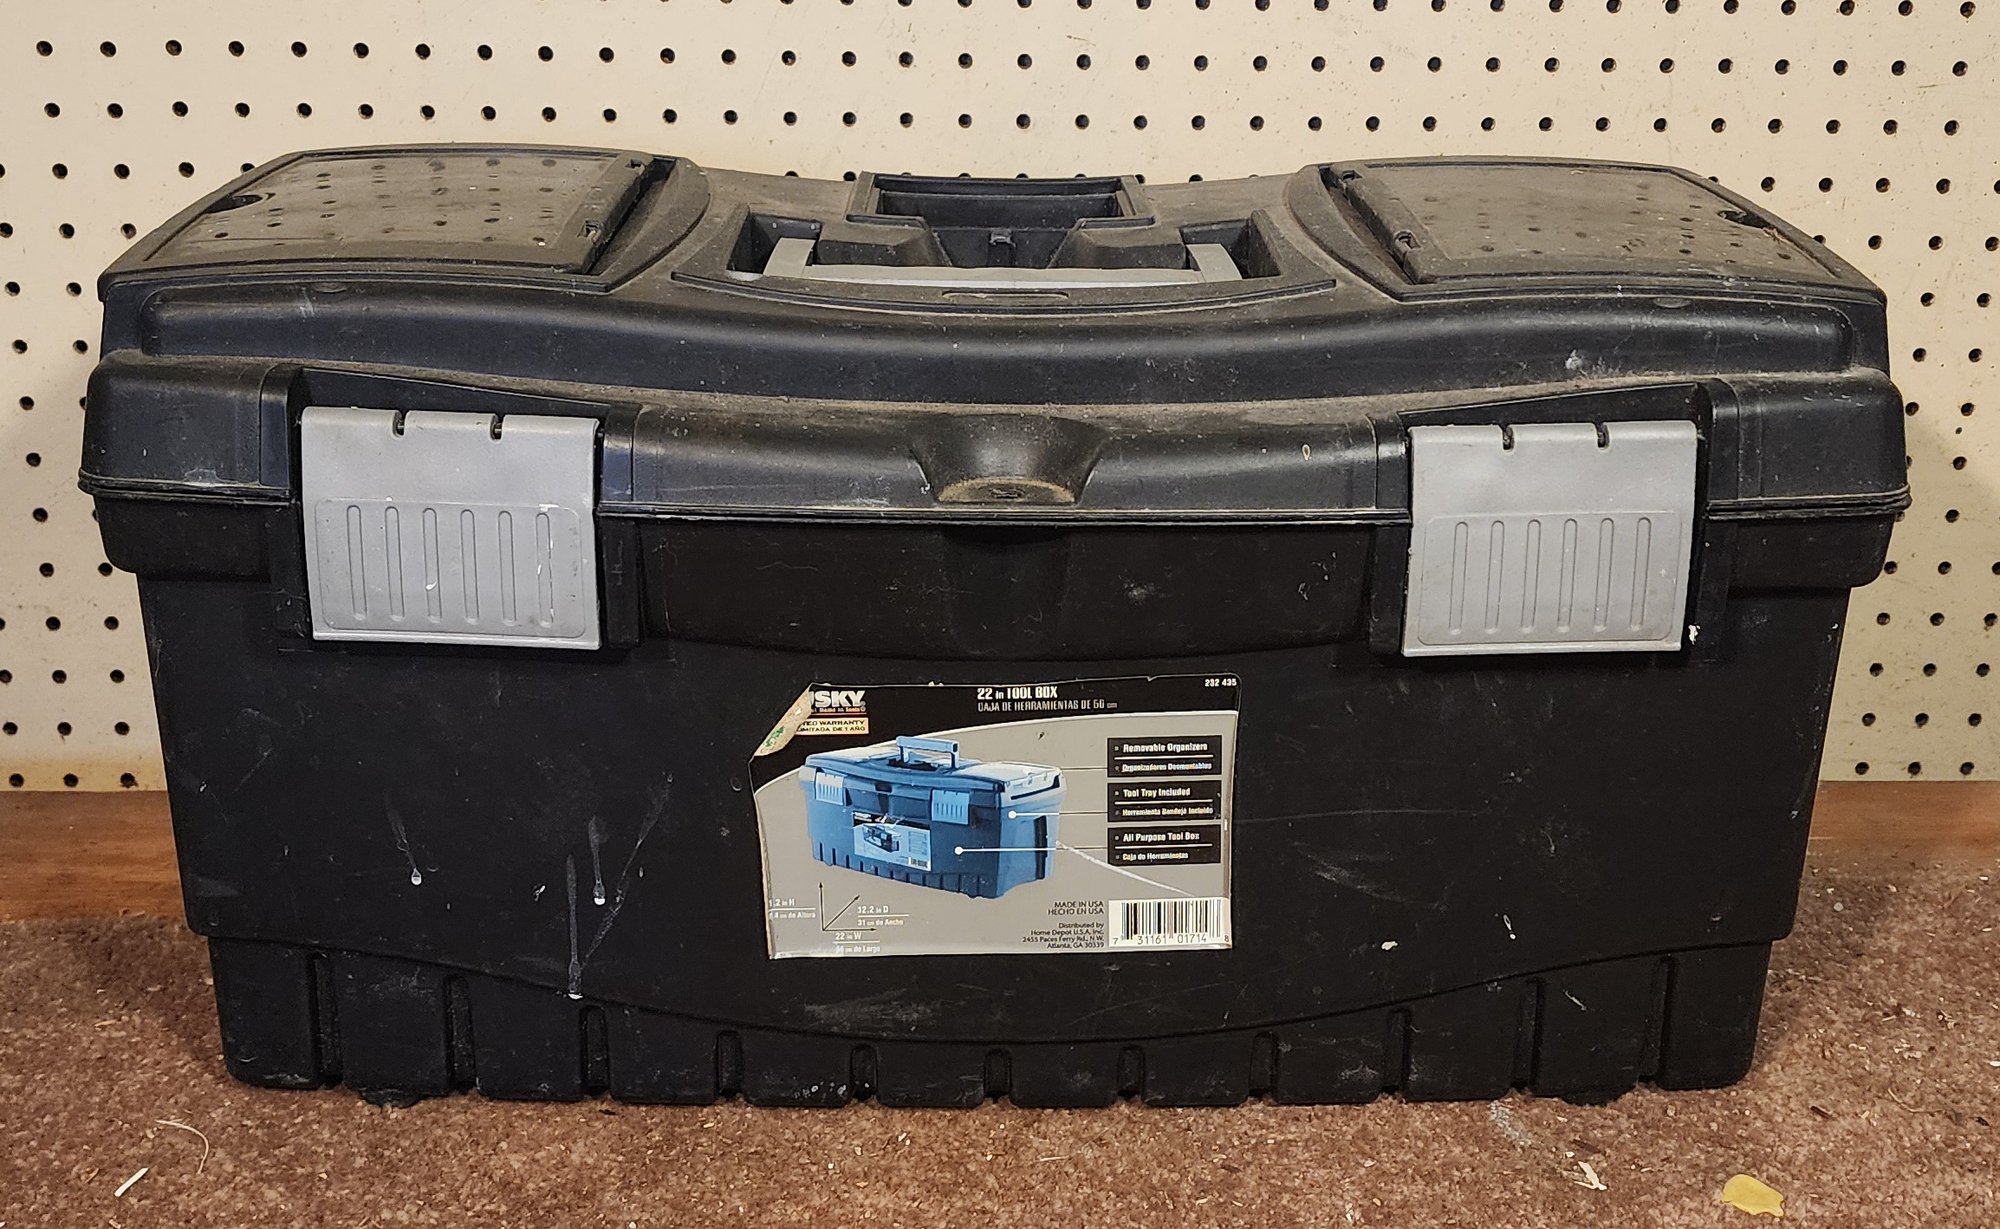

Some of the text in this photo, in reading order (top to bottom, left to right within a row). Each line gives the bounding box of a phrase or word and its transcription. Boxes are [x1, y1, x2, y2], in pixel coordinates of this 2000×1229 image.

[1221, 678, 1236, 686] 435
[977, 686, 1057, 699] 22 in TOOL BOX
[978, 702, 1000, 712] CAJA
[1002, 701, 1012, 711] DE
[1014, 699, 1078, 711] HERRAMIENTAS
[1081, 700, 1091, 709] DE
[1123, 743, 1208, 753] Removable Organizers
[1123, 788, 1191, 798] Tool Tray Included
[1123, 832, 1200, 842] All Purpose Tool Box
[789, 898, 795, 906] H
[882, 905, 889, 913] D
[835, 932, 845, 940] 22
[853, 931, 862, 940] W
[1051, 929, 1072, 938] Depot
[1058, 935, 1075, 944] Ferry
[1112, 933, 1230, 945] 7 31161 01714 8
[1084, 941, 1105, 949] 30339
